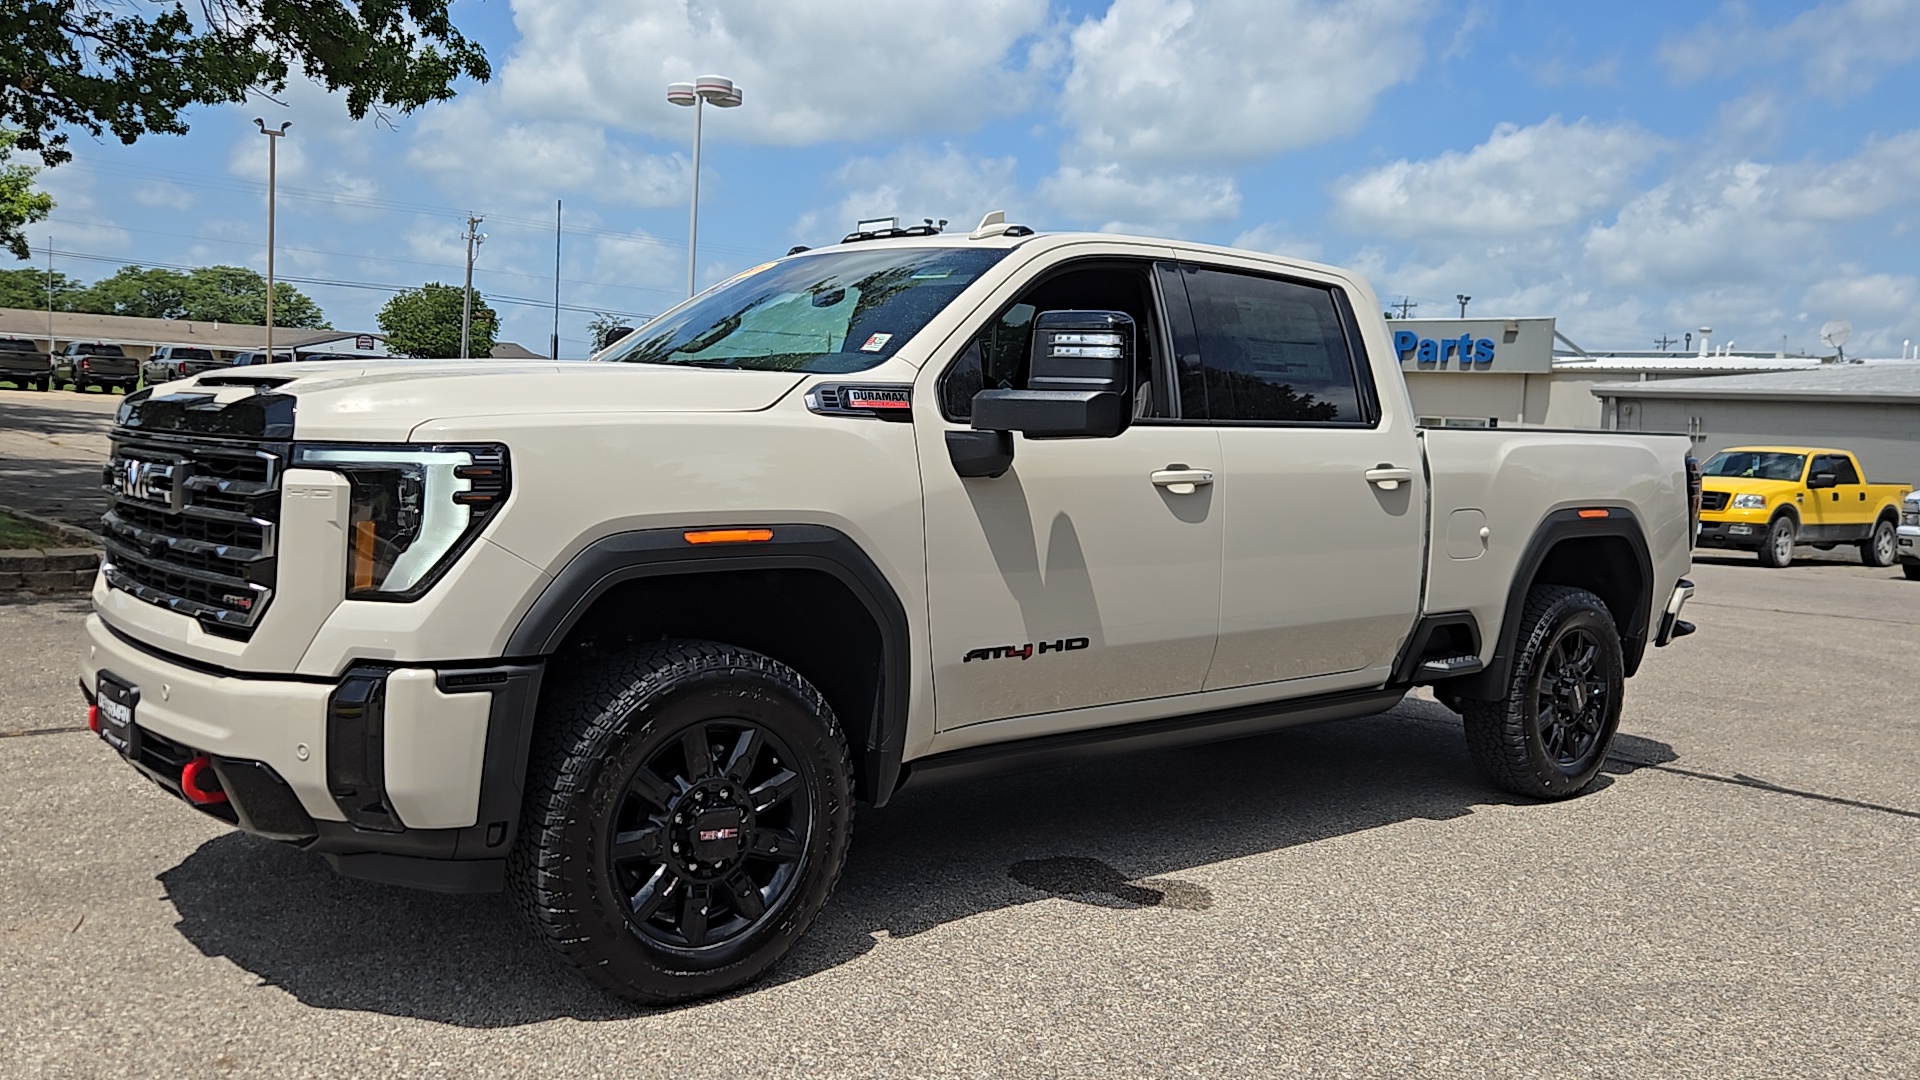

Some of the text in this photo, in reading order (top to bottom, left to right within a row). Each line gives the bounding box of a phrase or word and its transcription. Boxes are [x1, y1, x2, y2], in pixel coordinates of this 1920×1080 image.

[1394, 330, 1495, 363] Parts
[852, 391, 906, 402] DURAMAX
[286, 488, 333, 499] HD
[963, 637, 1089, 662] AT4 HD
[700, 828, 738, 840] GMC
